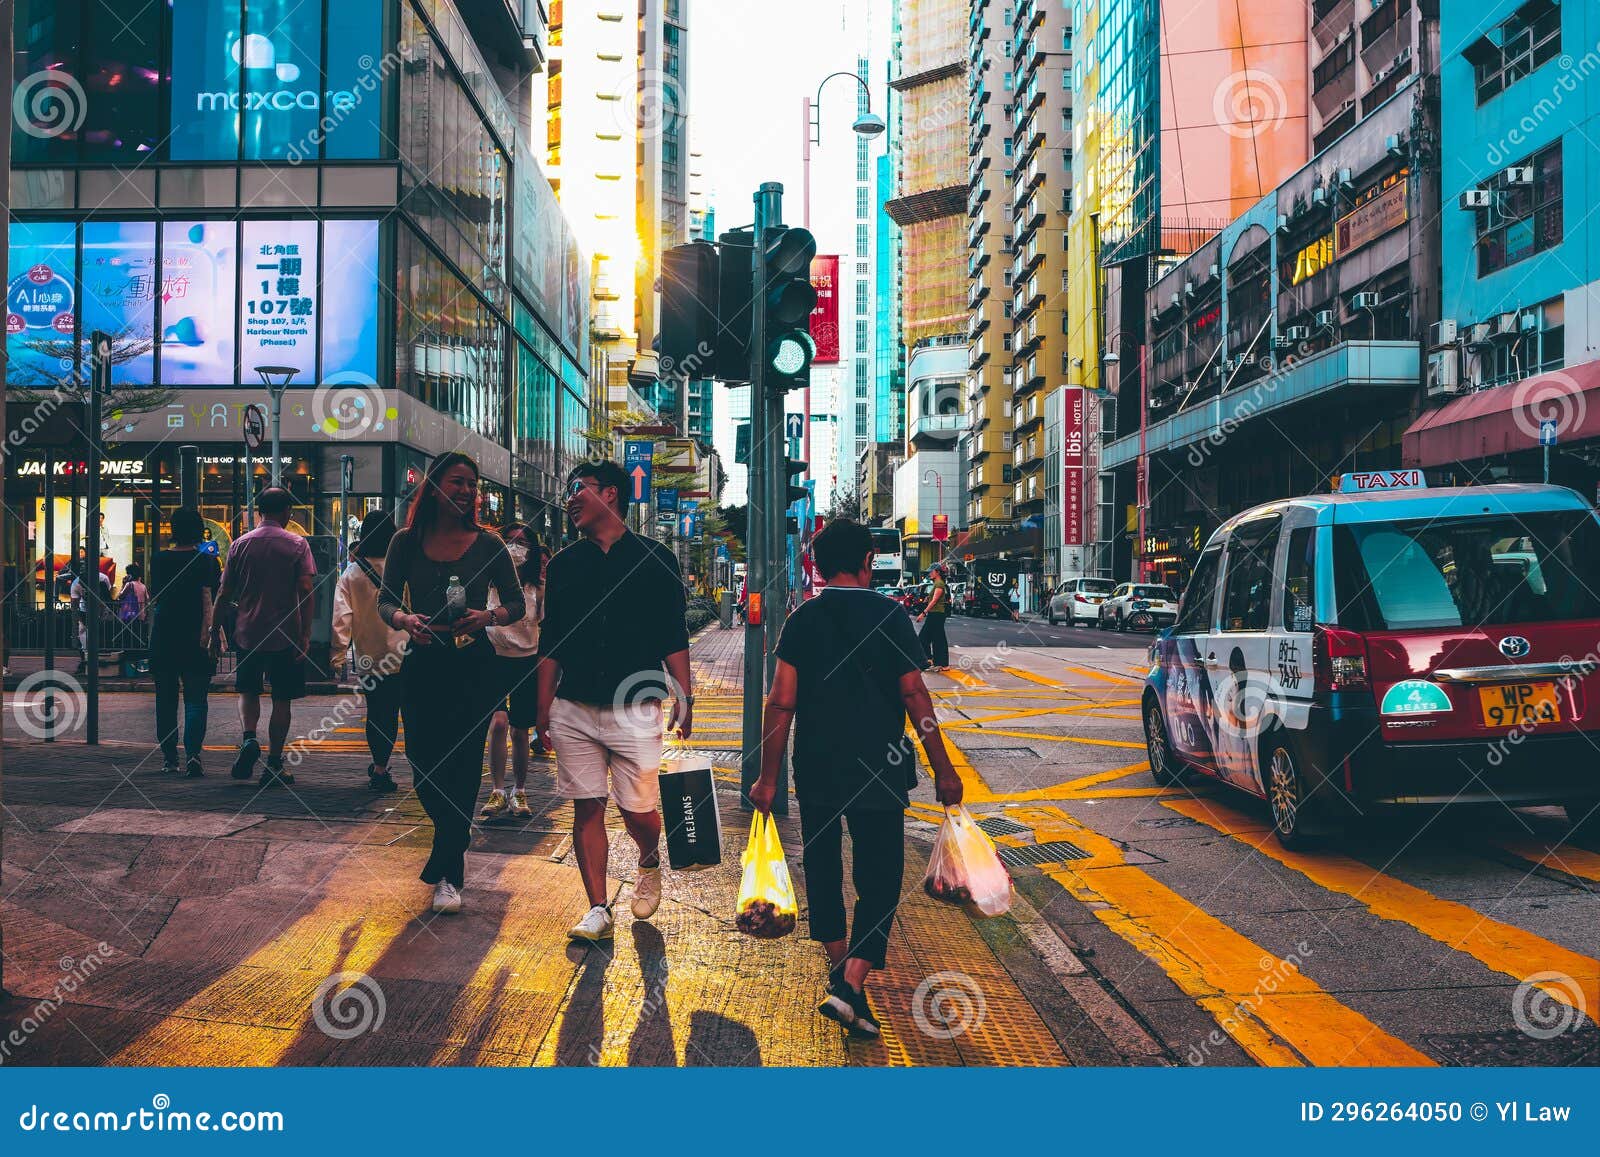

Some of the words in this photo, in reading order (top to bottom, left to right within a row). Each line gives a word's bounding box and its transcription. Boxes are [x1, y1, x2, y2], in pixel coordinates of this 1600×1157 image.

[197, 90, 356, 111] maxcare
[256, 258, 302, 276] 一期
[248, 297, 313, 315] 107號
[246, 328, 281, 336] Harbour
[283, 328, 308, 336] North
[247, 318, 269, 326] Shop
[1073, 400, 1082, 425] HOTEL
[629, 445, 638, 455] P
[1066, 431, 1082, 457] ibis
[1352, 471, 1419, 489] TAXI
[1278, 640, 1299, 662] 的士
[1278, 663, 1302, 690] TAXI
[1407, 689, 1422, 703] 4
[1501, 685, 1534, 706] WP
[1488, 702, 1556, 726] 9704
[683, 795, 697, 843] #AEJEANS
